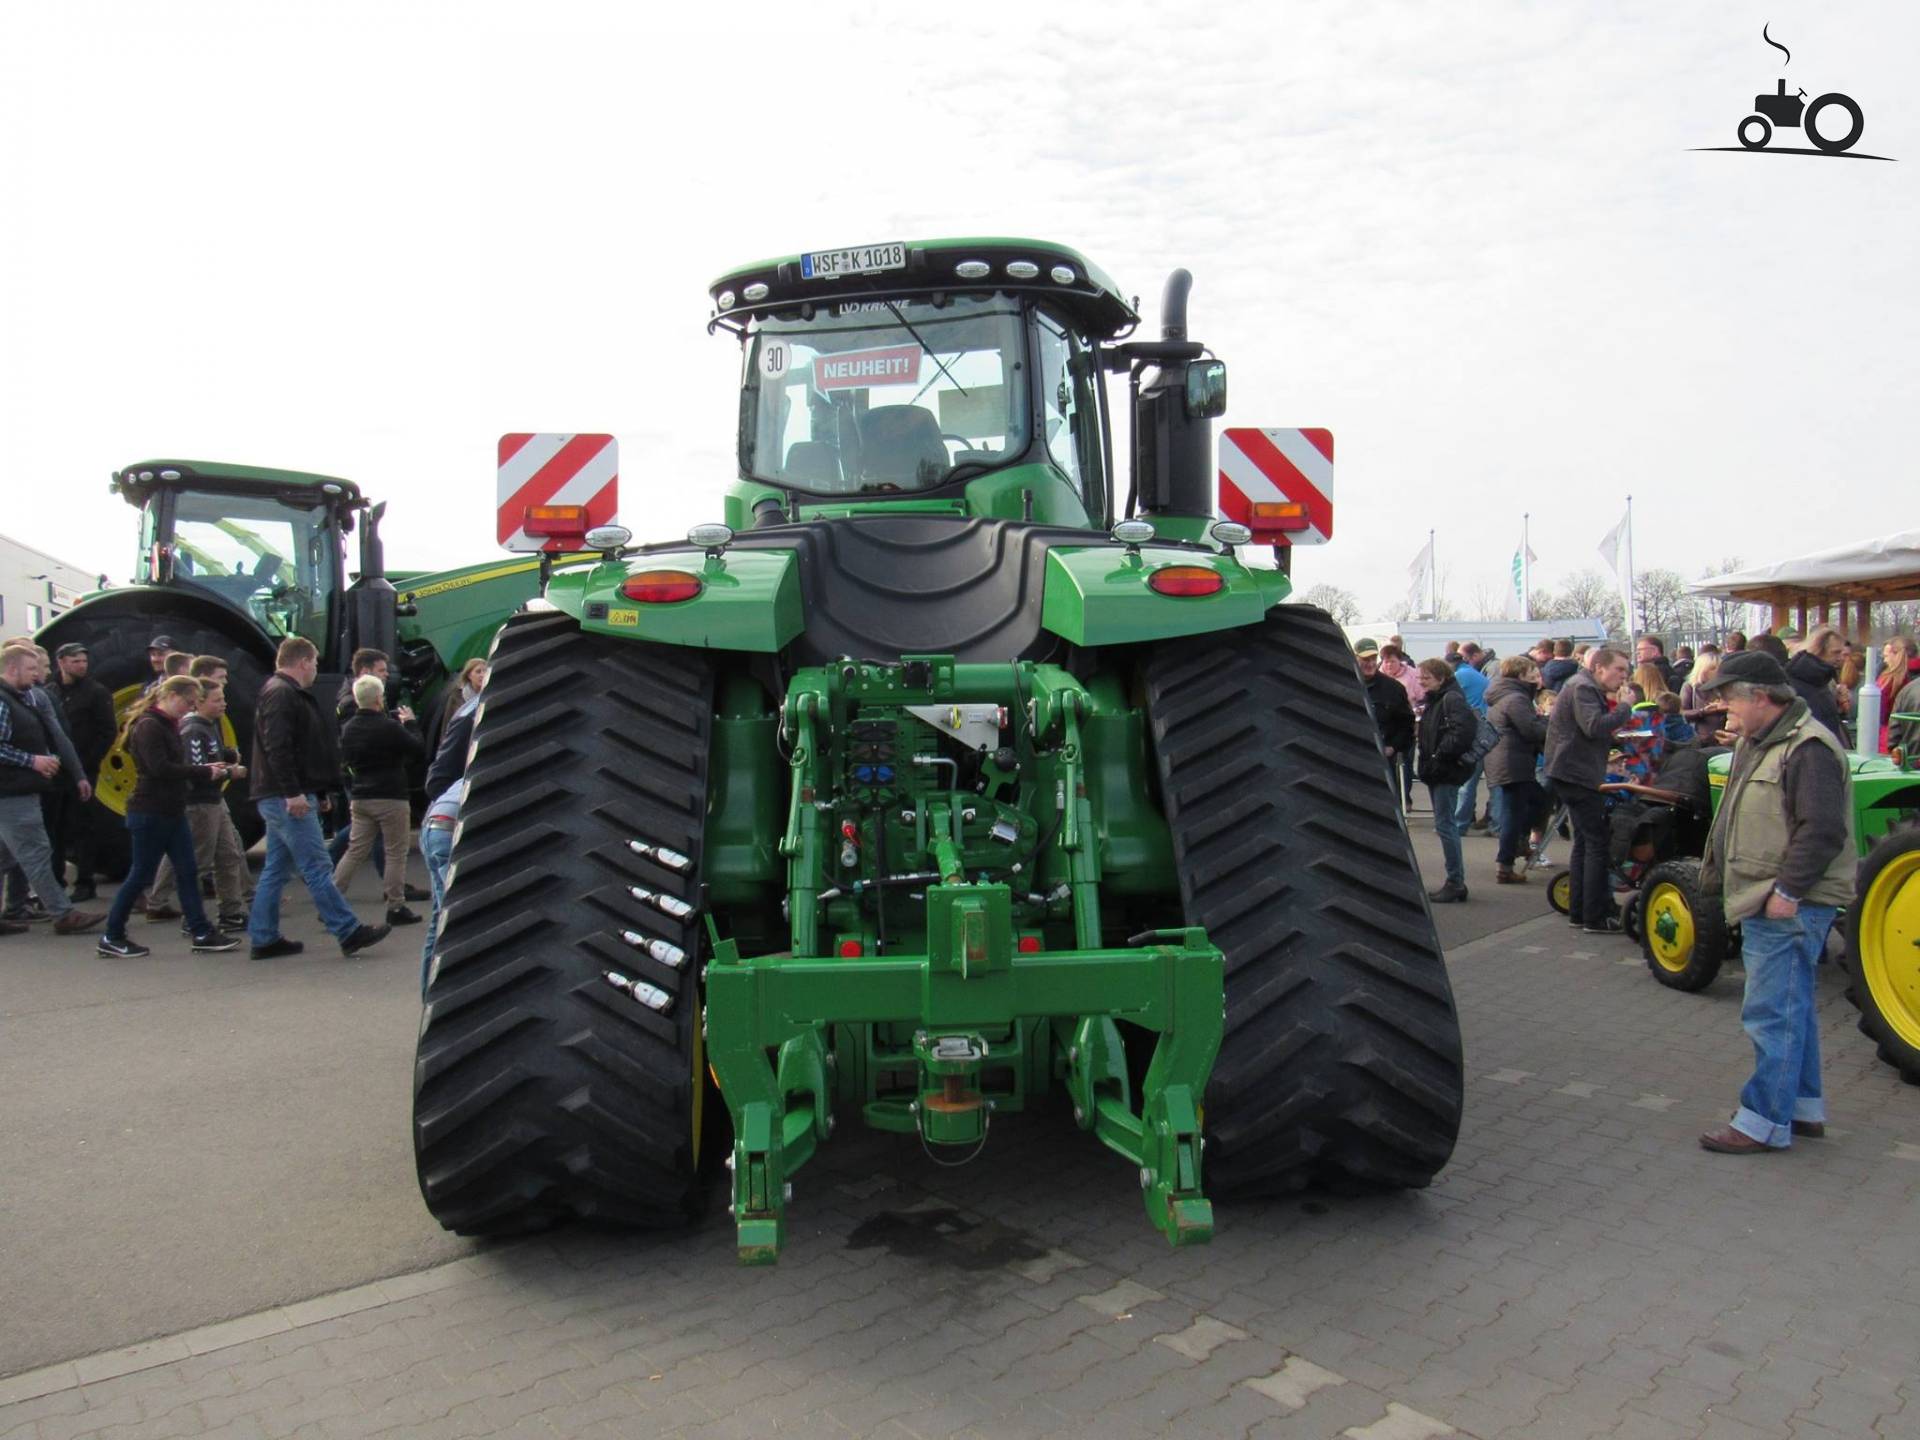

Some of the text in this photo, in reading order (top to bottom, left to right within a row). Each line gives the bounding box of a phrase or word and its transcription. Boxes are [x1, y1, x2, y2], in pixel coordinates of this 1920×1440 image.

[812, 253, 839, 274] WSF
[851, 251, 861, 269] K
[864, 246, 902, 268] 1018
[767, 346, 783, 372] 30
[823, 358, 909, 379] NEUHEIT!
